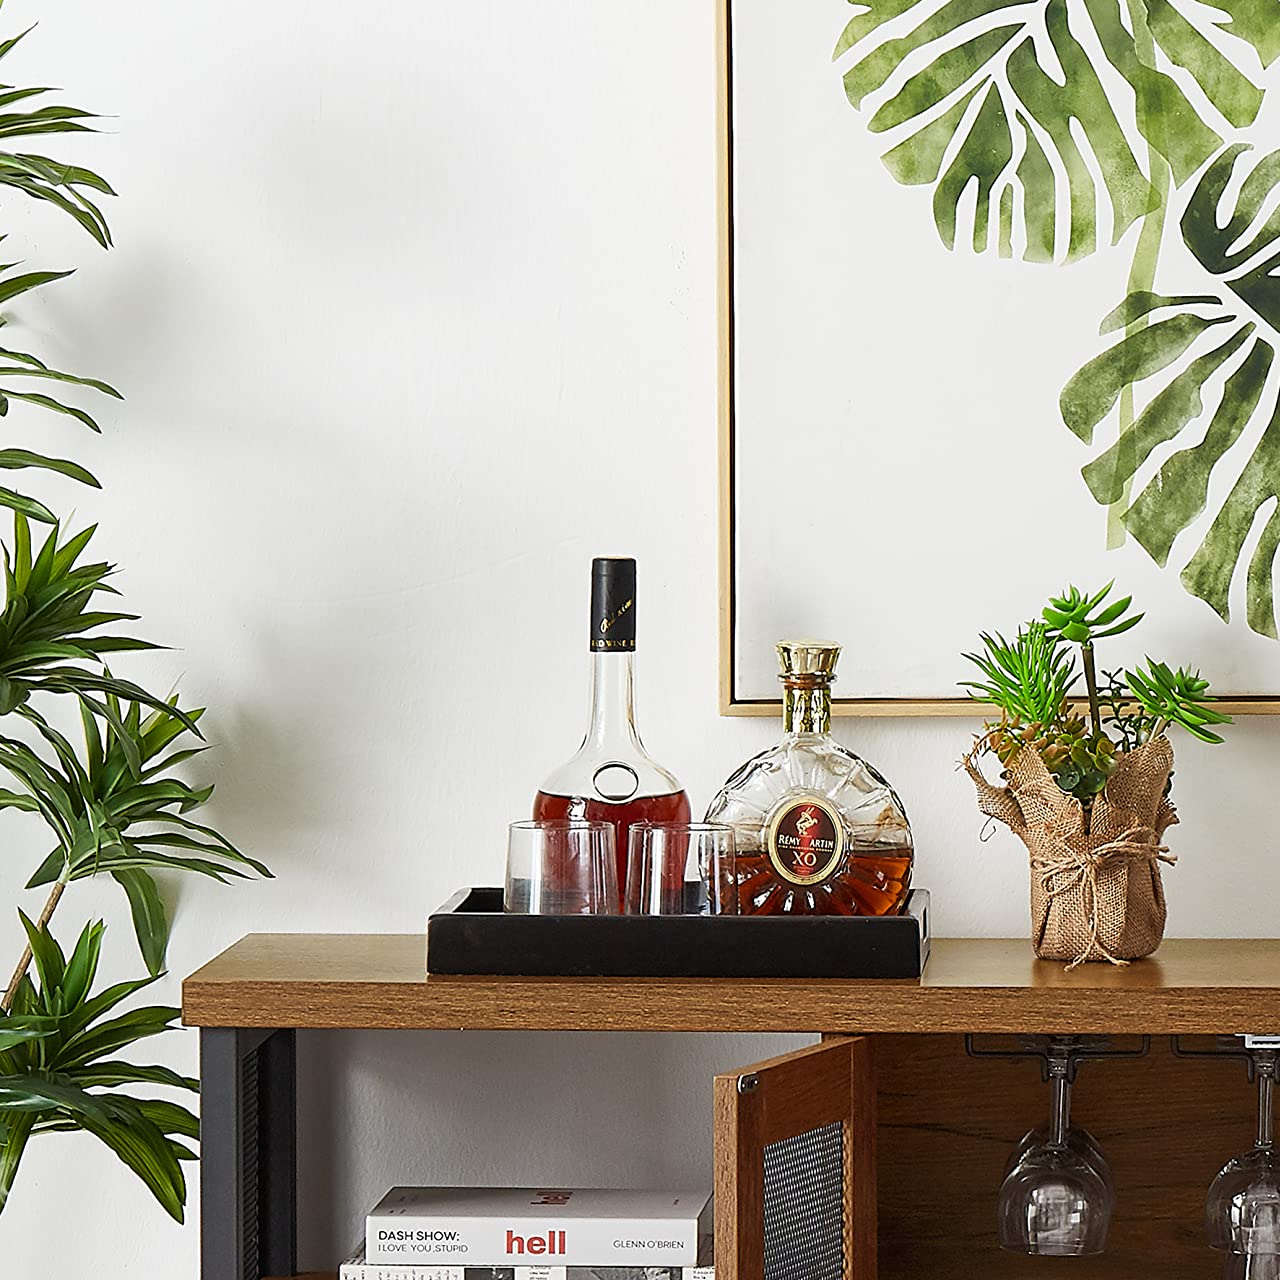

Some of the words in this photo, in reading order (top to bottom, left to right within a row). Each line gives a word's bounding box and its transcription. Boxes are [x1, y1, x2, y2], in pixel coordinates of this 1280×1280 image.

[792, 850, 817, 867] XO
[378, 1230, 414, 1241] DASH
[416, 1230, 460, 1242] SHOW:
[382, 1243, 407, 1252] LOVE
[506, 1230, 566, 1255] hell
[613, 1240, 646, 1249] GLENN
[647, 1240, 684, 1249] O'BRIEN
